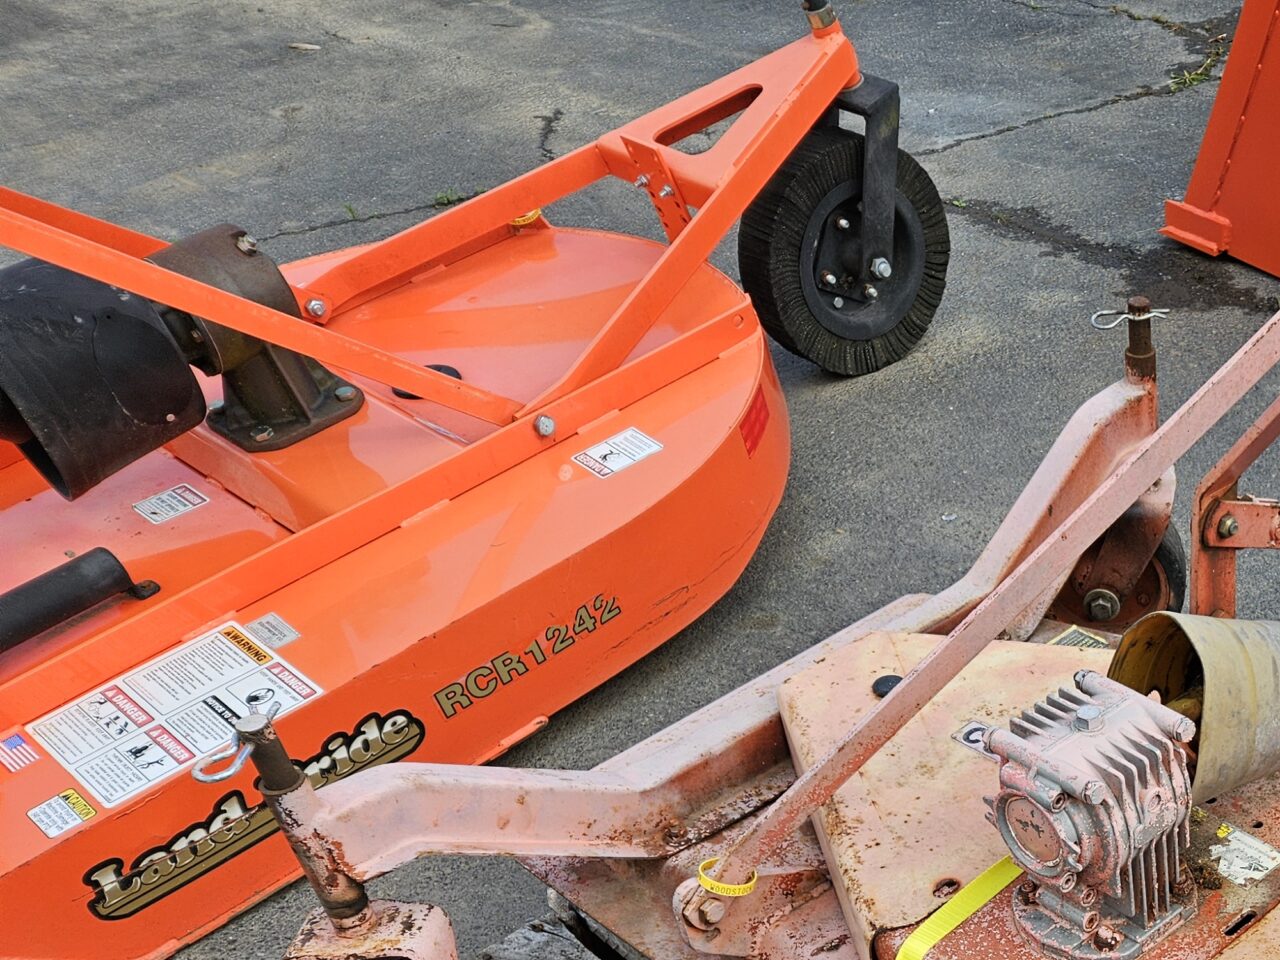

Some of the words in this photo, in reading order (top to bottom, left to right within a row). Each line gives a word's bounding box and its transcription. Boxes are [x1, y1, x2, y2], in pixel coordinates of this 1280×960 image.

[229, 630, 267, 662] WARNING
[433, 593, 622, 719] RCR1242
[279, 668, 310, 697] DANGER
[113, 694, 148, 725] DANGER
[156, 733, 189, 760] DANGER
[92, 795, 251, 907] Land
[300, 714, 411, 787] ride
